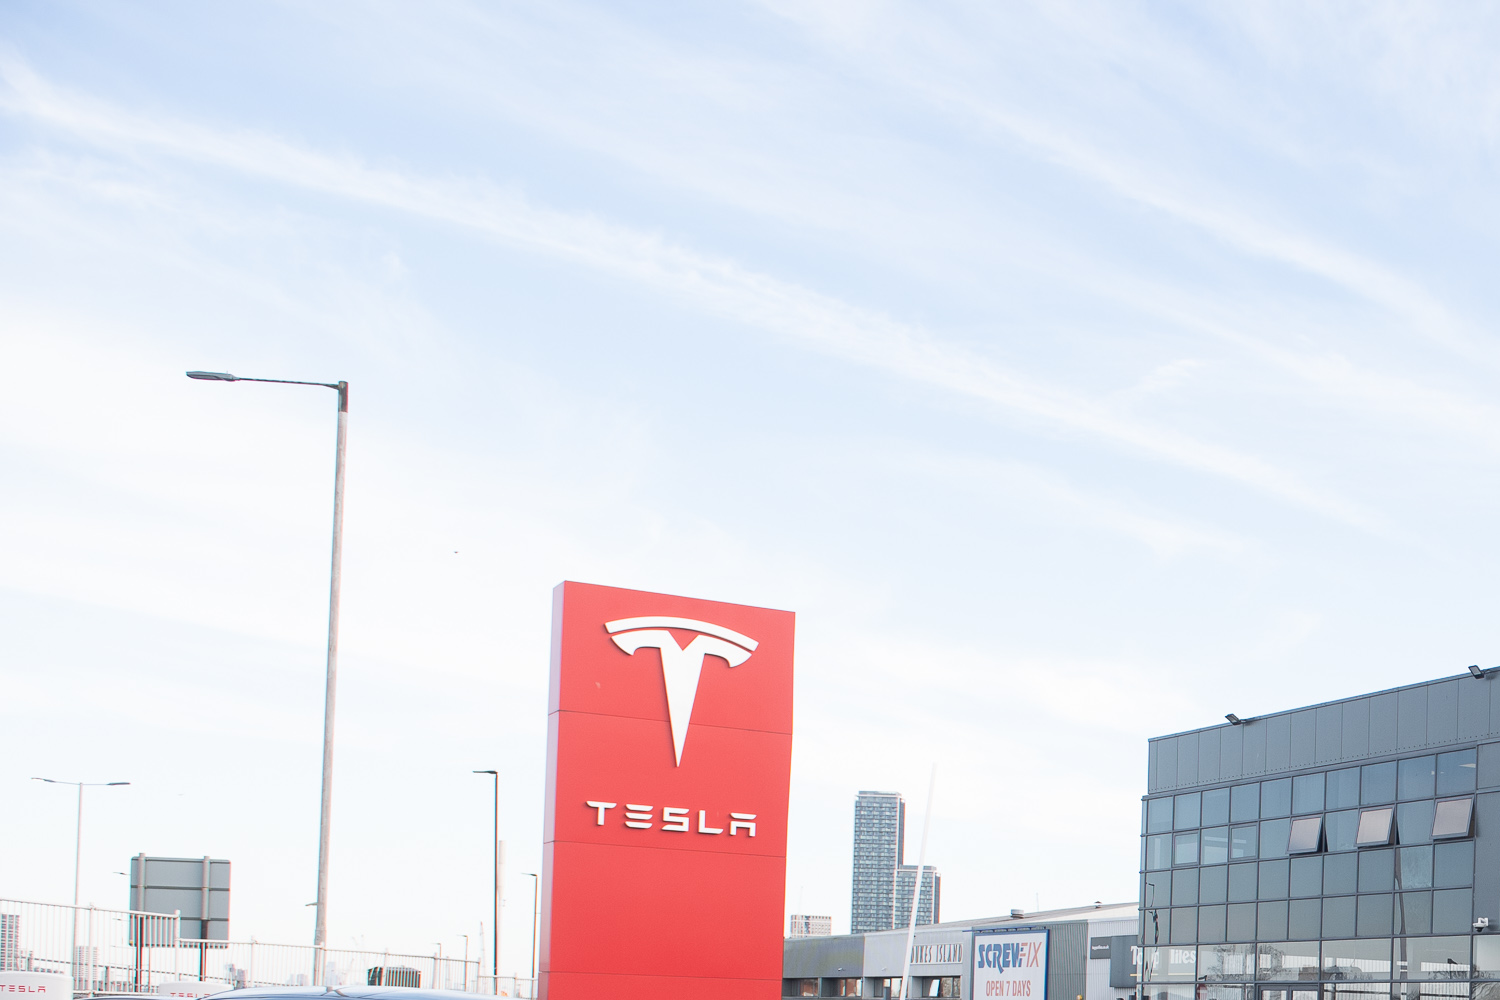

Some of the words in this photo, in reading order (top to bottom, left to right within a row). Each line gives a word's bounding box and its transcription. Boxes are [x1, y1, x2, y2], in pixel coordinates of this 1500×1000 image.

[585, 800, 757, 837] TESLA
[936, 943, 963, 963] ISLAND
[978, 942, 1042, 974] SCREWFIX
[0, 984, 46, 993] TESLA
[986, 980, 1004, 997] OPEN
[1006, 980, 1010, 997] 7
[1012, 980, 1031, 997] DAYS
